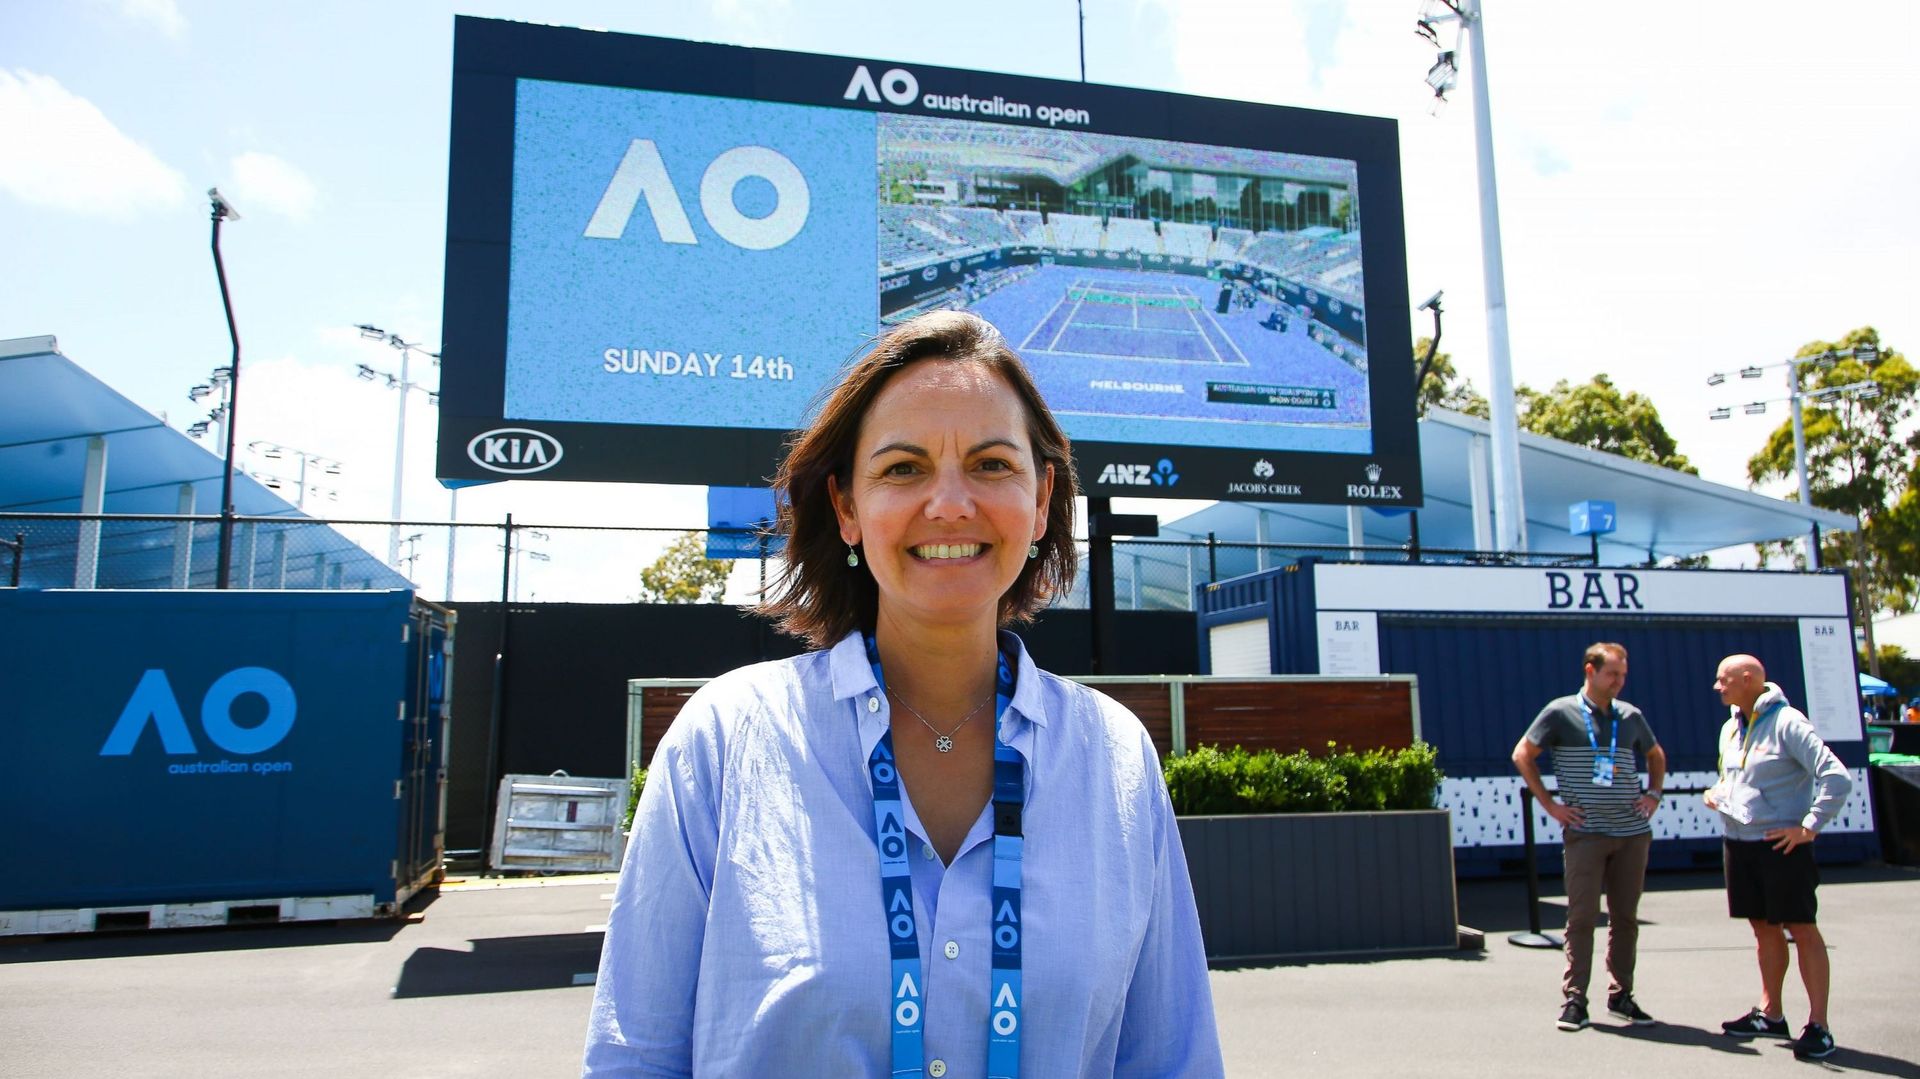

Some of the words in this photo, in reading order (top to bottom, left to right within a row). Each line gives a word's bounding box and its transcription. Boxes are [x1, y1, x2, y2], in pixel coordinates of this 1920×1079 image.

[843, 65, 920, 106] AO
[923, 92, 1032, 119] australian
[1036, 105, 1091, 127] open
[583, 138, 811, 250] AO
[603, 348, 723, 377] SUNDAY
[730, 354, 794, 380] 14th
[1090, 380, 1185, 394] MELBOURNE
[484, 437, 548, 464] KIA
[1097, 463, 1152, 485] ANZ
[1227, 482, 1267, 494] JACOB'S
[1269, 483, 1302, 495] CREEK
[1346, 484, 1403, 499] ROLEX
[1603, 513, 1613, 529] 7
[1545, 572, 1644, 609] BAR
[1335, 620, 1360, 631] BAR
[1814, 625, 1835, 636] BAR
[99, 666, 298, 756] AO
[168, 760, 248, 774] australian
[252, 760, 293, 776] open
